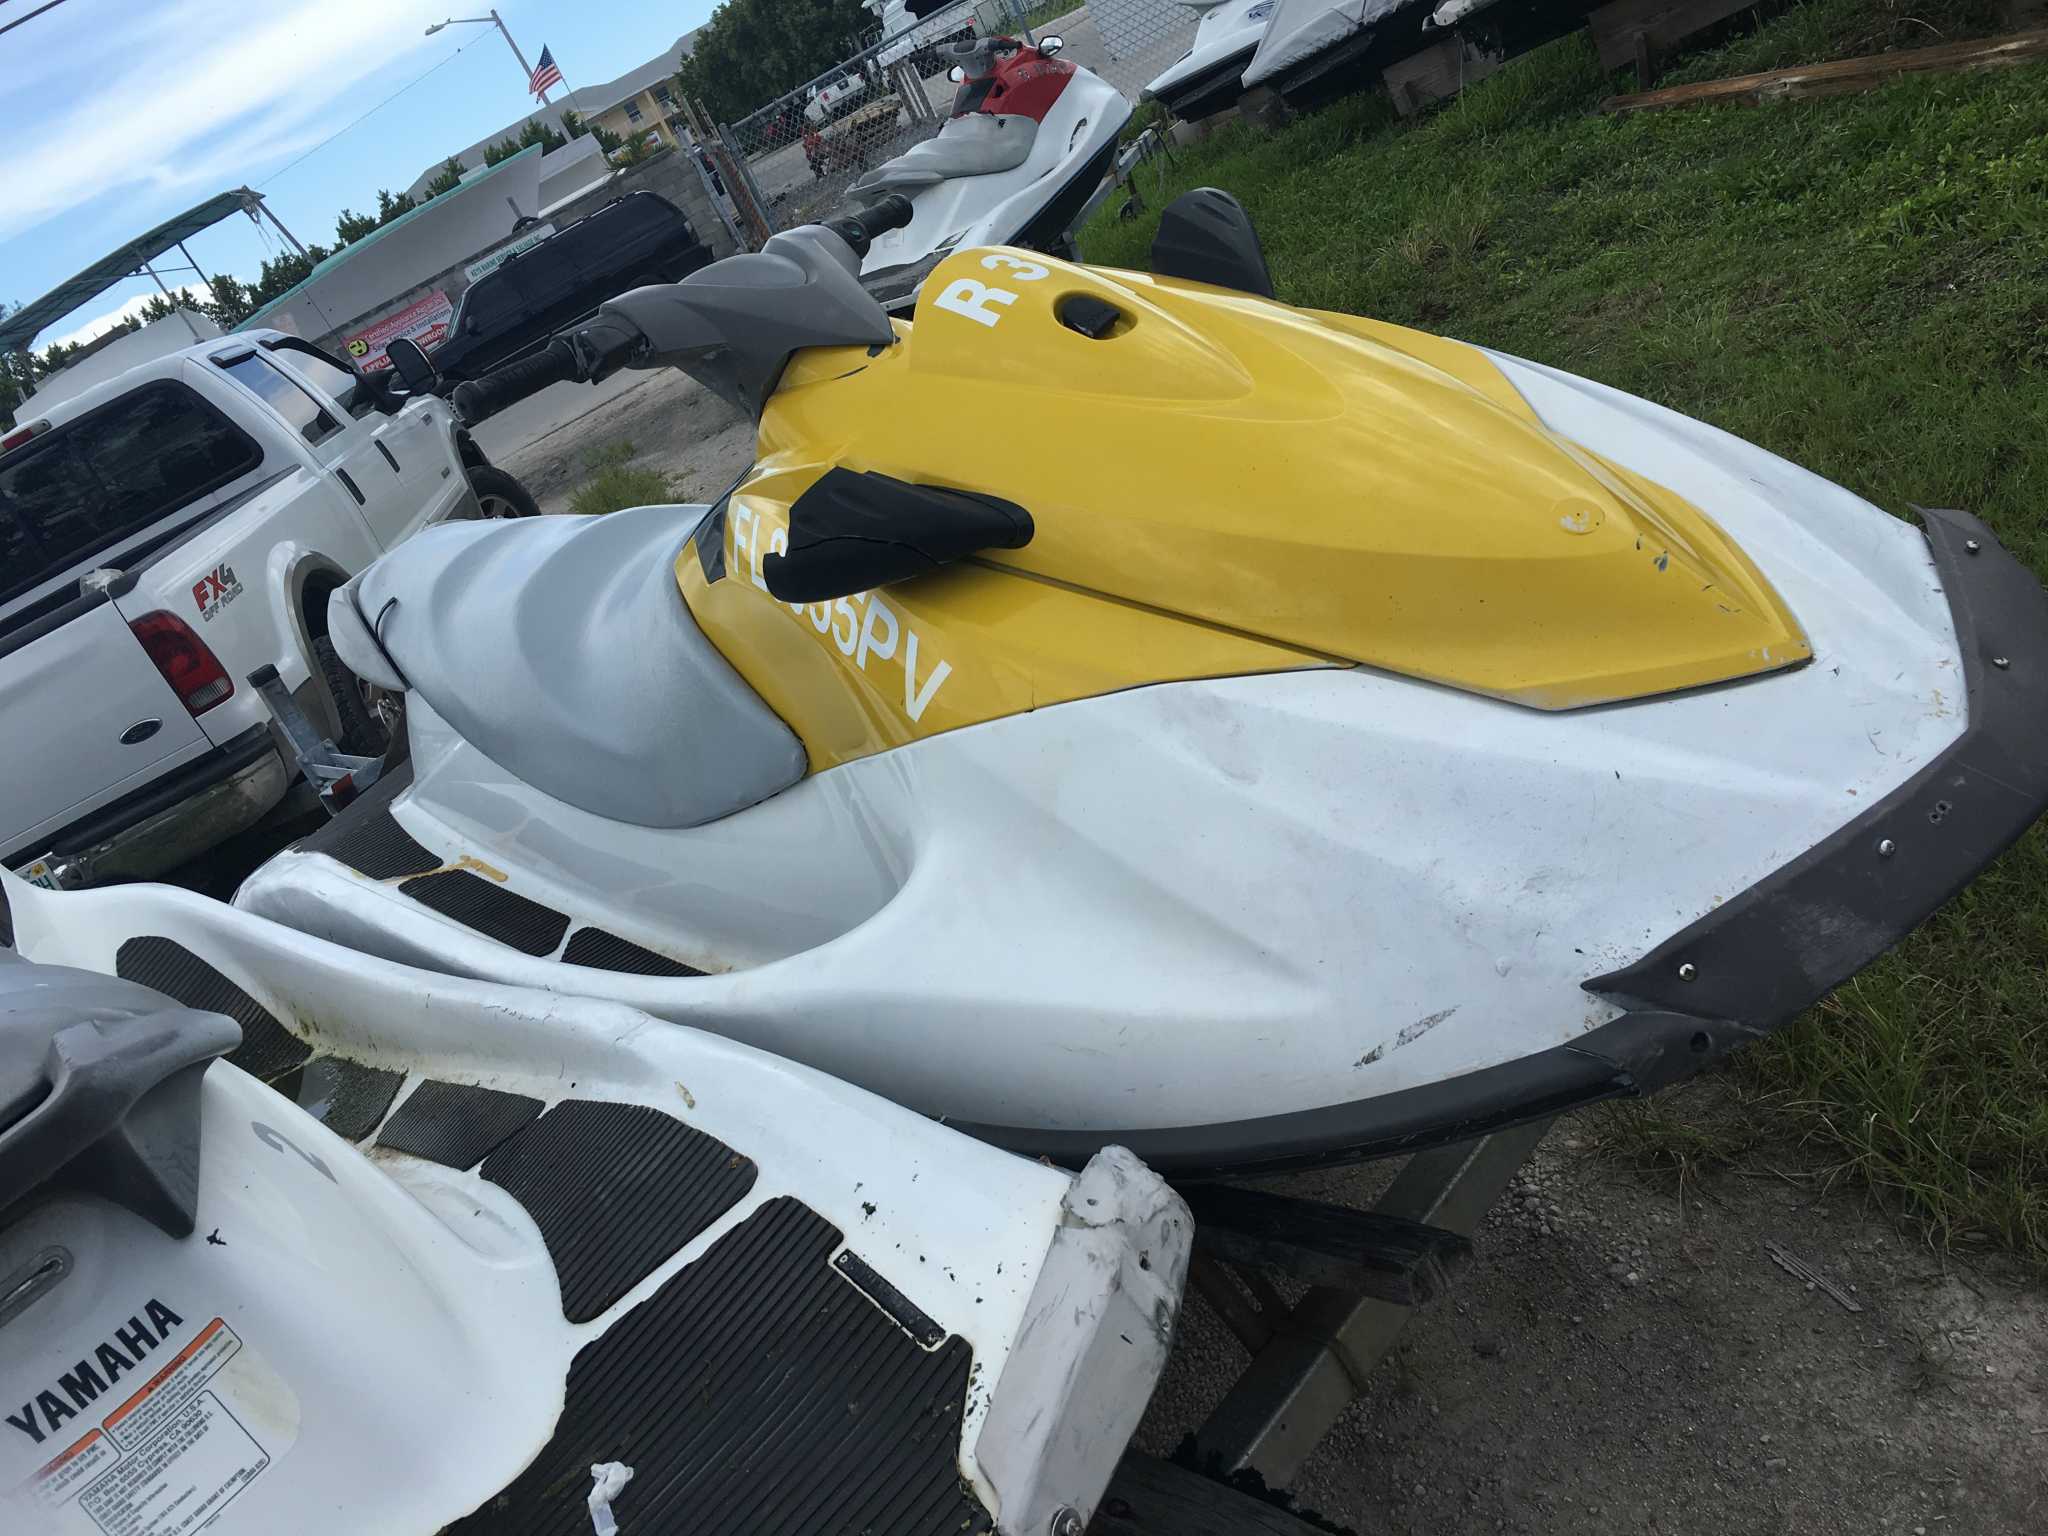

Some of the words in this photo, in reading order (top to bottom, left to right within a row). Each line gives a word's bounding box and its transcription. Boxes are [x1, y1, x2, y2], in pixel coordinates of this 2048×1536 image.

[933, 278, 1019, 328] R
[980, 254, 1049, 281] 3
[363, 354, 392, 374] APPLIA
[192, 563, 237, 611] FX4
[5, 1298, 184, 1444] YAMAHA
[116, 1453, 139, 1476] Motor
